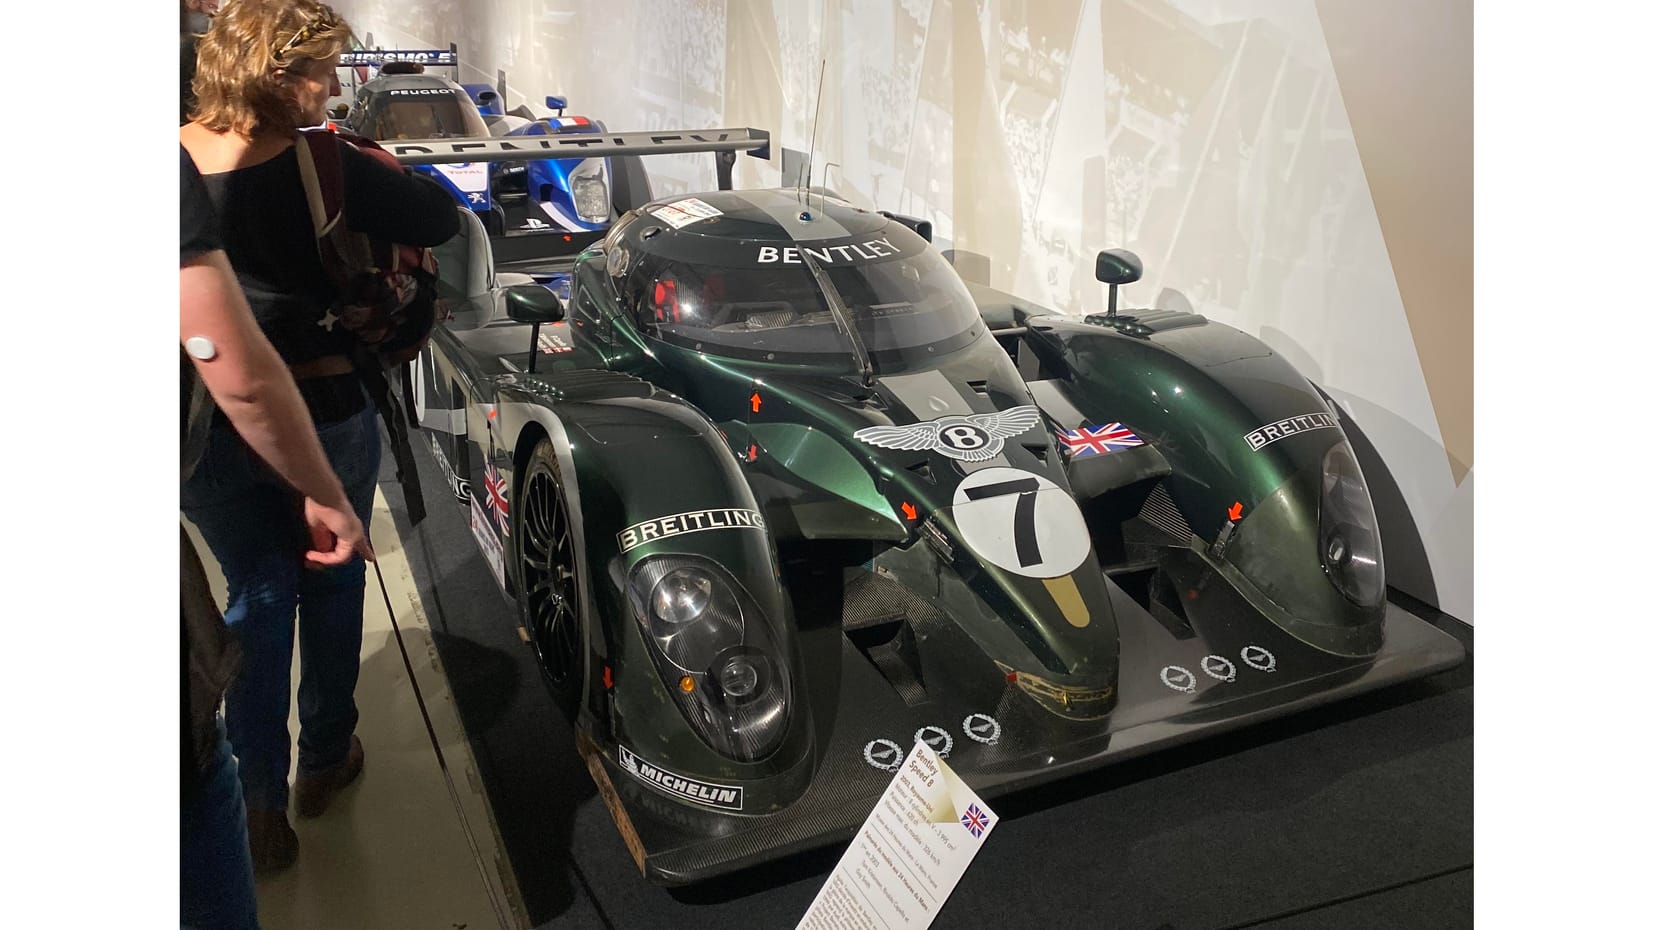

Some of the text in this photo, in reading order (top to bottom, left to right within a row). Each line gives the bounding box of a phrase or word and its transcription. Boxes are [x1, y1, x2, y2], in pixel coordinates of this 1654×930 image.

[391, 88, 456, 96] PEUGEOT
[757, 237, 901, 264] BENTLEY
[619, 511, 765, 550] BREITLING
[963, 477, 1043, 568] 7
[908, 759, 928, 784] Speed
[914, 748, 939, 777] Bentley
[639, 764, 737, 803] MICHELIN
[901, 877, 915, 895] Heures
